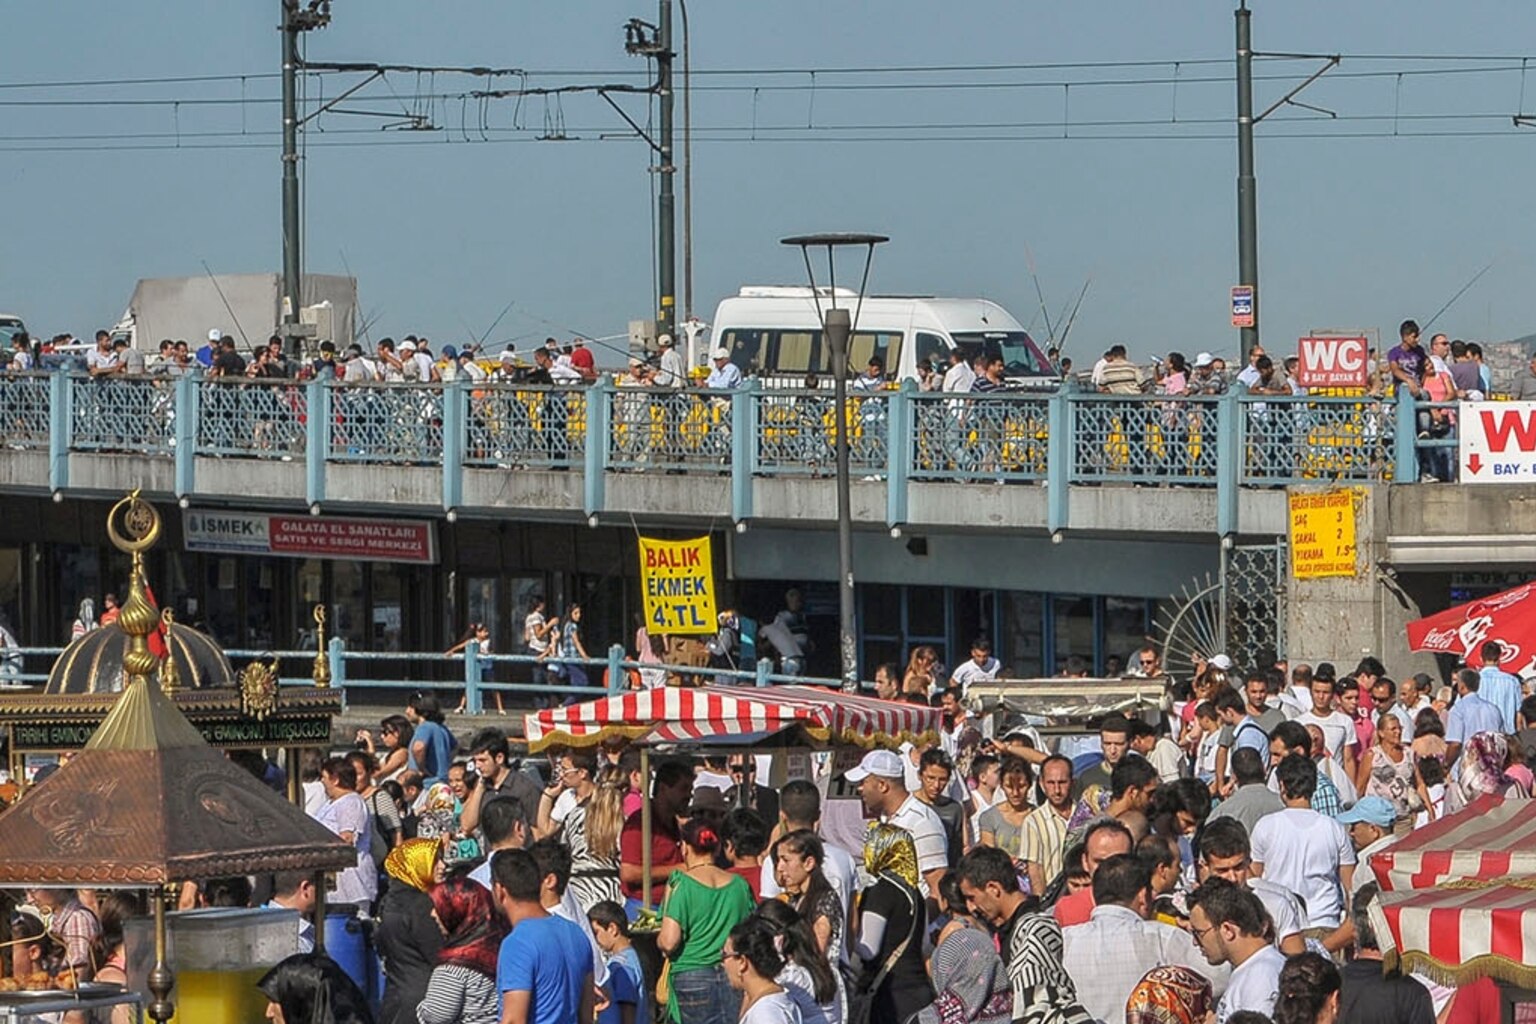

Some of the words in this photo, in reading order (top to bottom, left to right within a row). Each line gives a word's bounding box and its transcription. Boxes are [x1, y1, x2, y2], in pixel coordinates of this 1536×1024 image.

[1303, 340, 1363, 371] WC
[1493, 463, 1521, 475] BAY
[1336, 511, 1343, 523] 3
[280, 521, 328, 534] GALATA
[330, 523, 346, 535] EL
[349, 525, 417, 539] SANATLARI
[1336, 528, 1343, 540] 2
[310, 536, 327, 545] VE
[646, 547, 701, 568] BALIK
[647, 576, 707, 597] EKMEK
